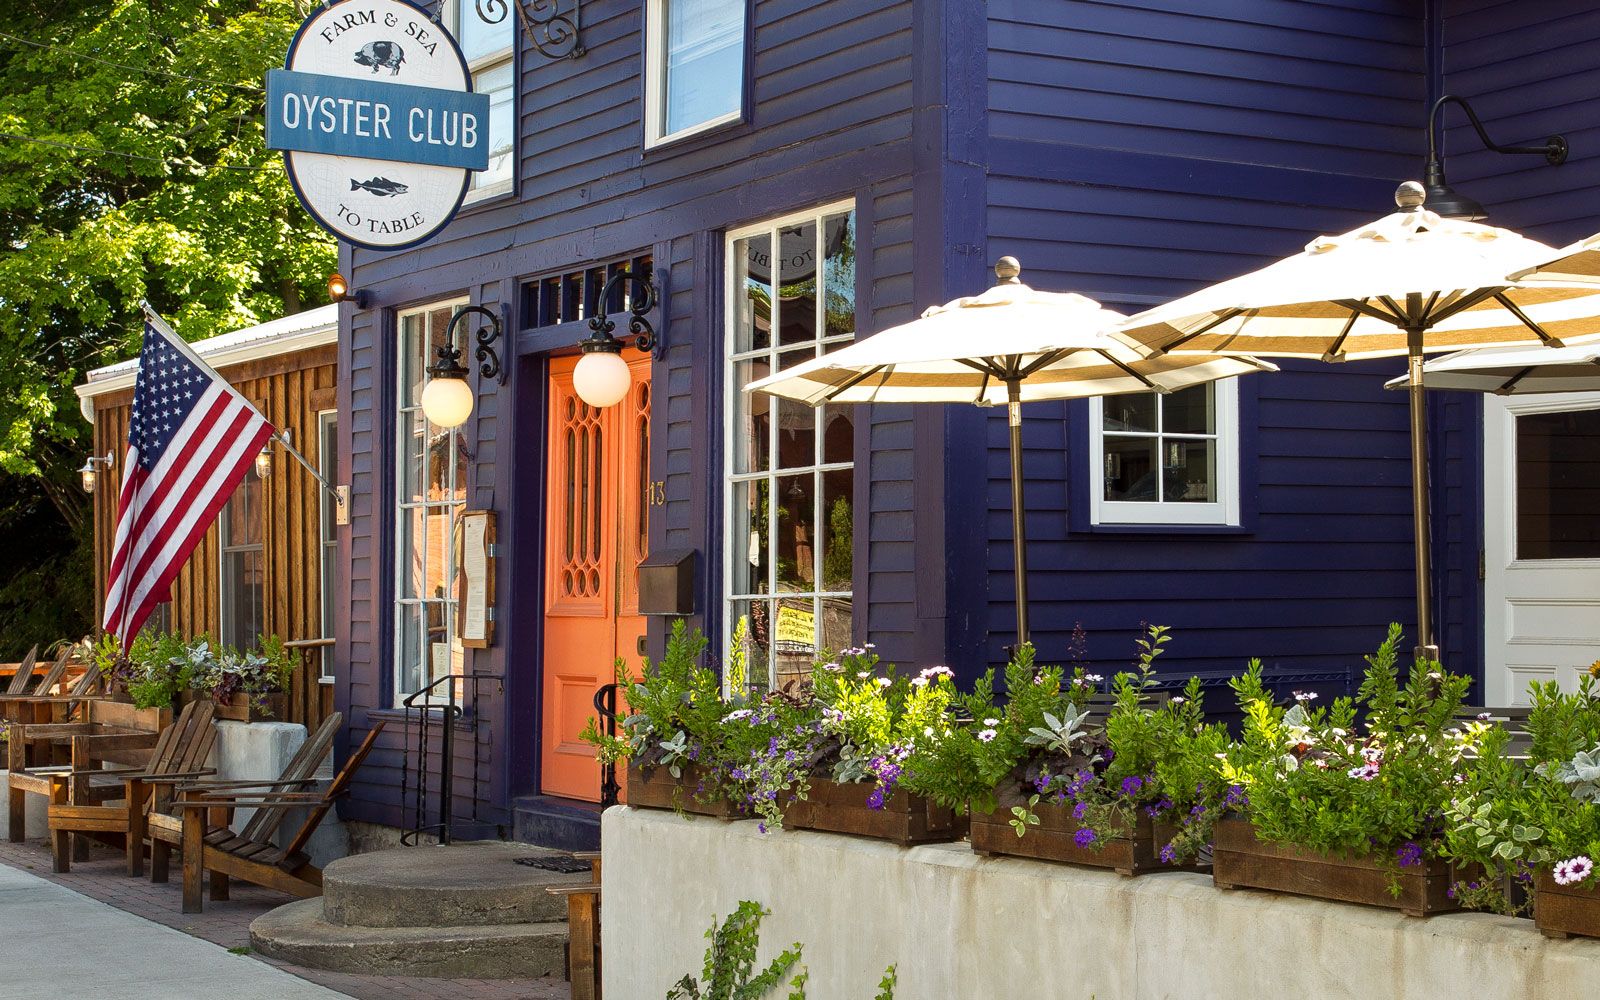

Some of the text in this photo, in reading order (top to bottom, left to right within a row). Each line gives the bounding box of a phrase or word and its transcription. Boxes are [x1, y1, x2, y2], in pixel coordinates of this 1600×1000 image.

[320, 10, 440, 57] FARM & SEA
[283, 92, 477, 148] OYSTER CLUB
[337, 203, 425, 234] TO TABLE
[650, 481, 665, 505] 13
